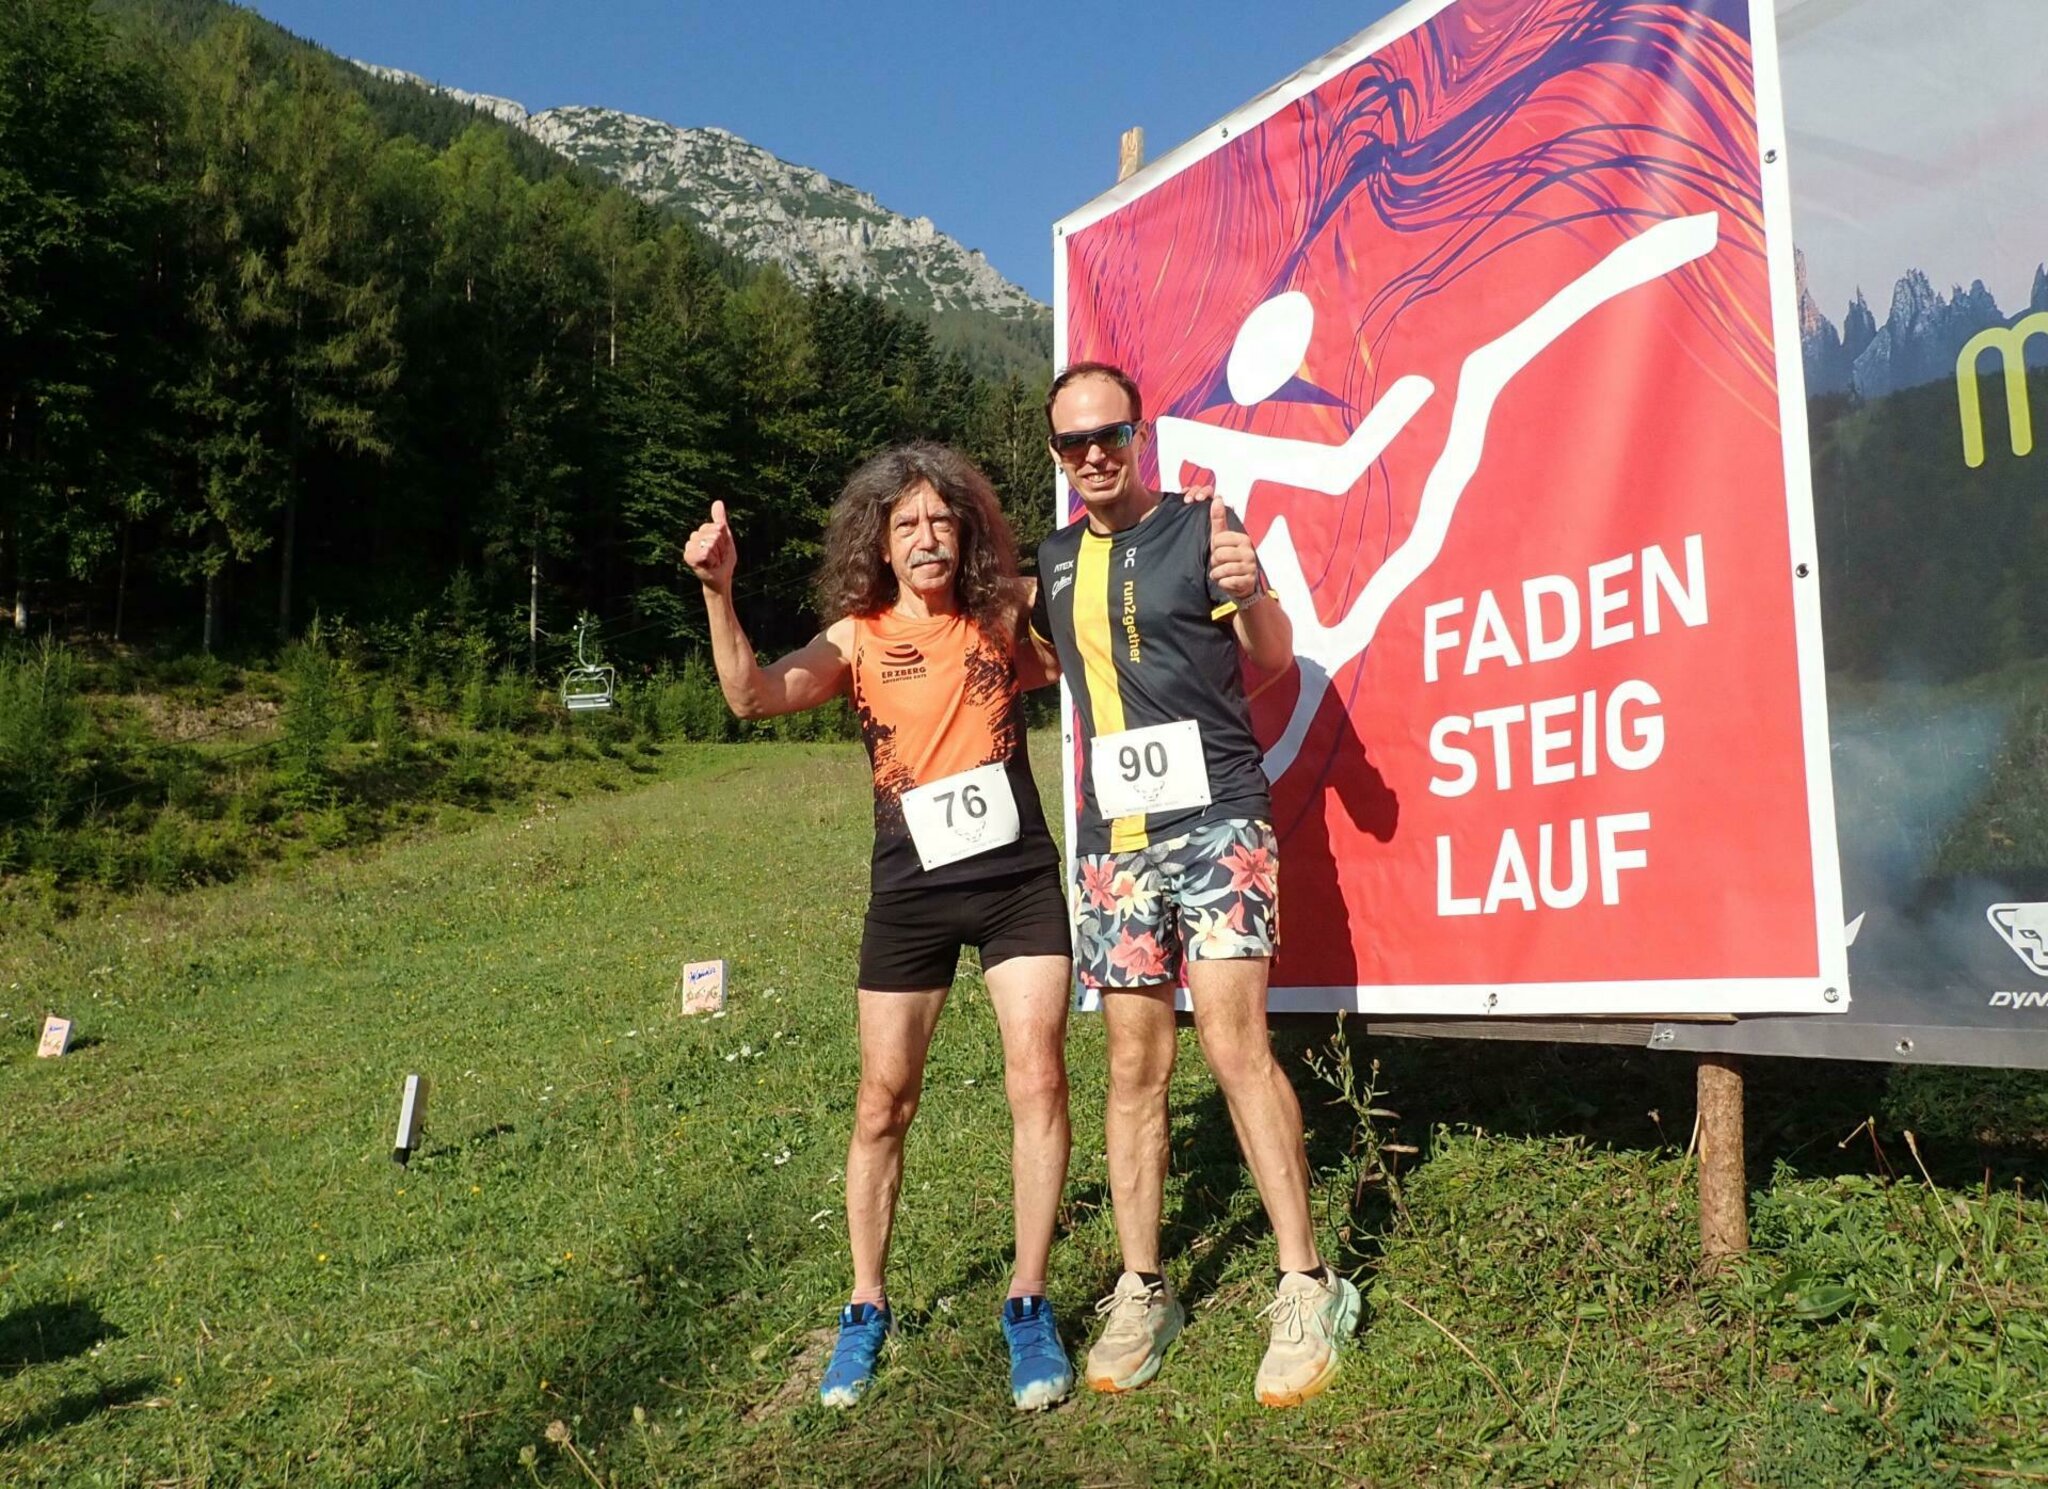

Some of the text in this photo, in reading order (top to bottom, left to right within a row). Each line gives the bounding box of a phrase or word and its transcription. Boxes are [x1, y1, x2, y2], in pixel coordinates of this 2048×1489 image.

[1122, 580, 1140, 664] run2gether
[1423, 533, 1709, 683] FADEN
[881, 666, 927, 679] ERZBERG
[1119, 741, 1168, 782] 90
[1428, 679, 1665, 798] STEIG
[933, 784, 987, 828] 76
[1436, 811, 1650, 916] LAUF
[1988, 991, 2048, 1009] DYN
